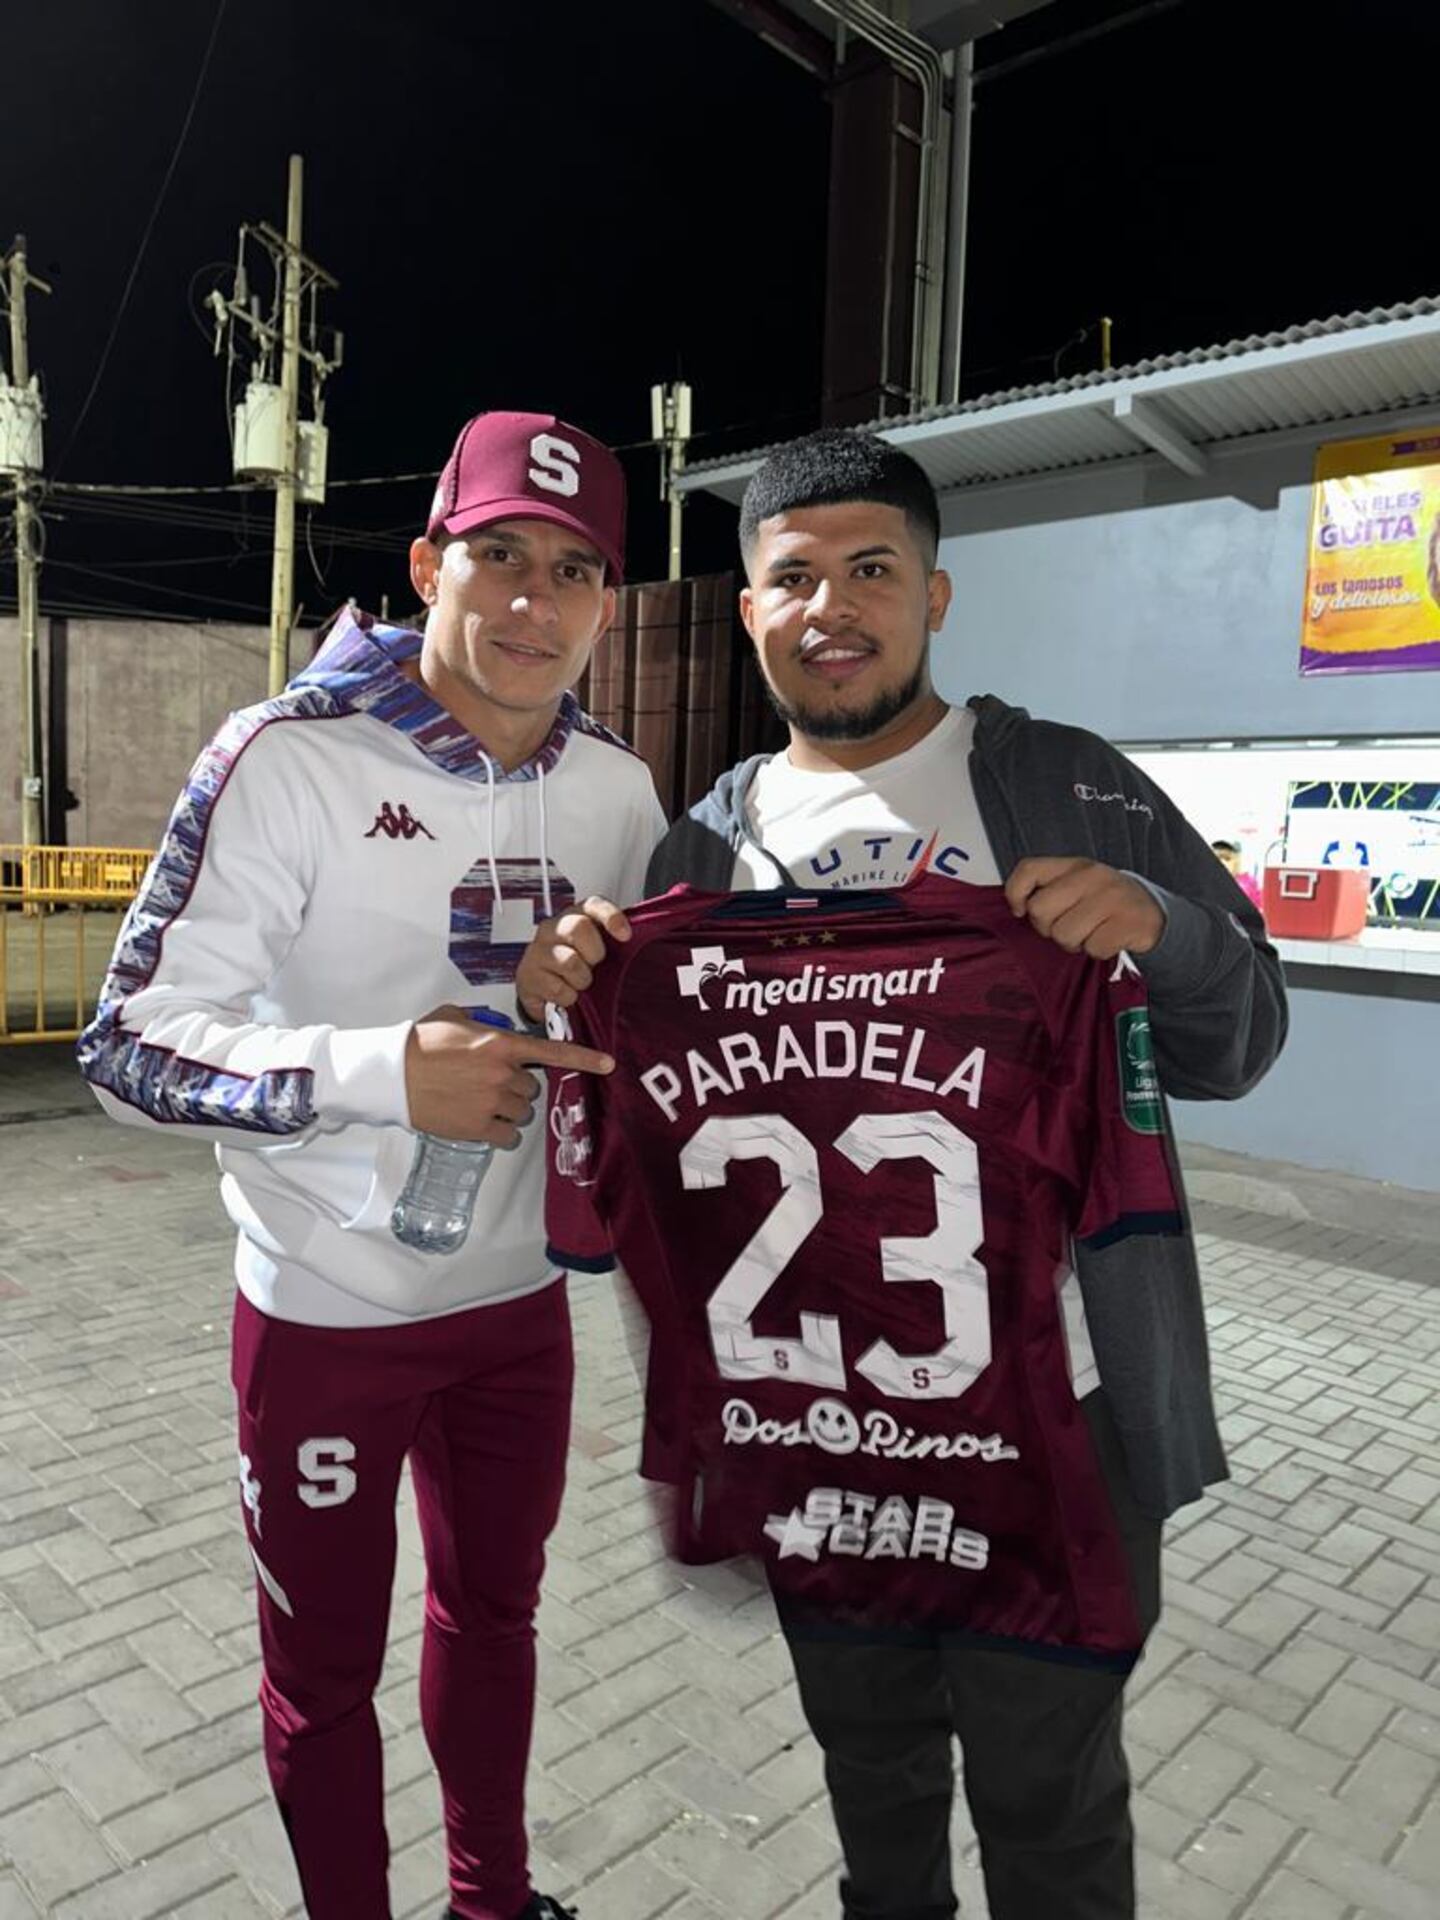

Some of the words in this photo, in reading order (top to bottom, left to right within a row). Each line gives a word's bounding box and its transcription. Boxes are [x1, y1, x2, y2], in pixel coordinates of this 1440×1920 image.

[529, 433, 580, 498] S
[1319, 515, 1416, 547] GUITA
[831, 870, 885, 891] MARINE
[724, 957, 945, 1016] medismart
[639, 1020, 986, 1123] PARADELA
[679, 1110, 992, 1399] 23
[773, 1349, 789, 1370] S
[912, 1367, 931, 1390] S
[722, 1398, 812, 1445] Dos
[861, 1410, 1020, 1462] Pinos
[298, 1436, 358, 1510] S
[803, 1487, 955, 1534] STAR
[828, 1515, 990, 1571] CARS
